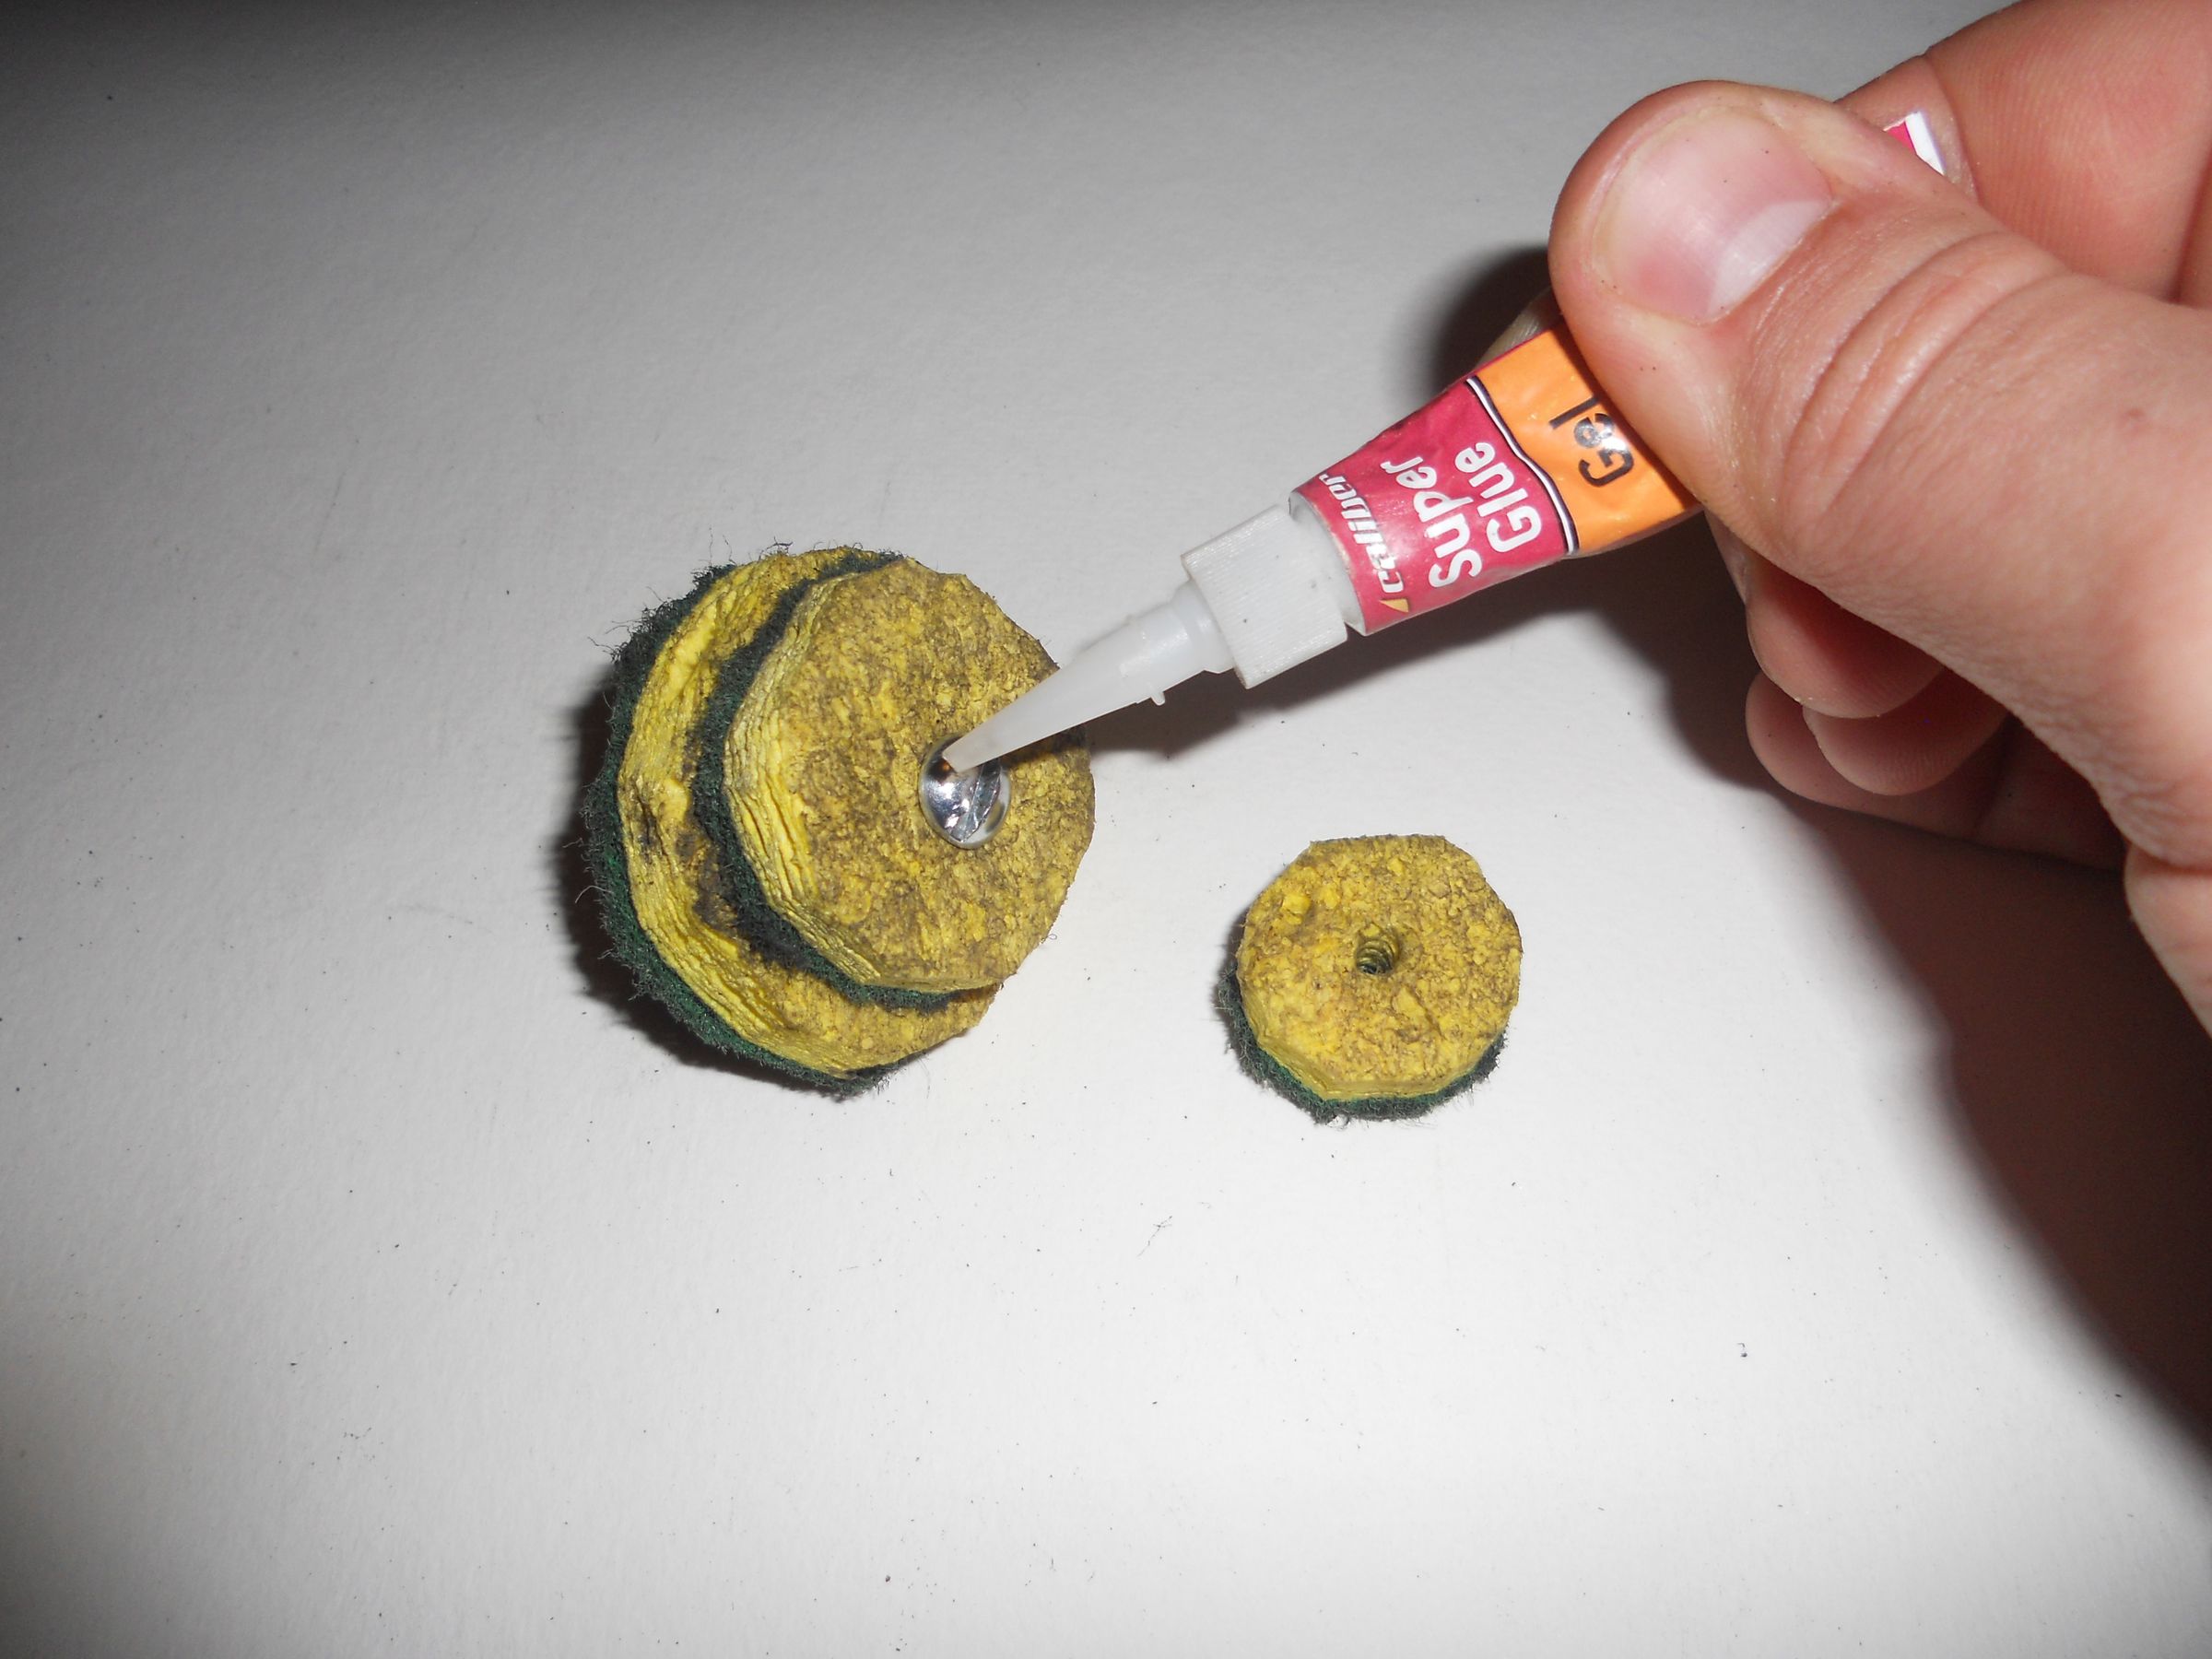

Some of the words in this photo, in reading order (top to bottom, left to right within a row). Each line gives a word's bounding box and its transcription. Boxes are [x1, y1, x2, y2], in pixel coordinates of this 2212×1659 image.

[1454, 441, 1542, 553] Glue
[1548, 395, 1634, 488] Gel
[1319, 474, 1404, 594] caliber
[1380, 456, 1483, 588] Super
